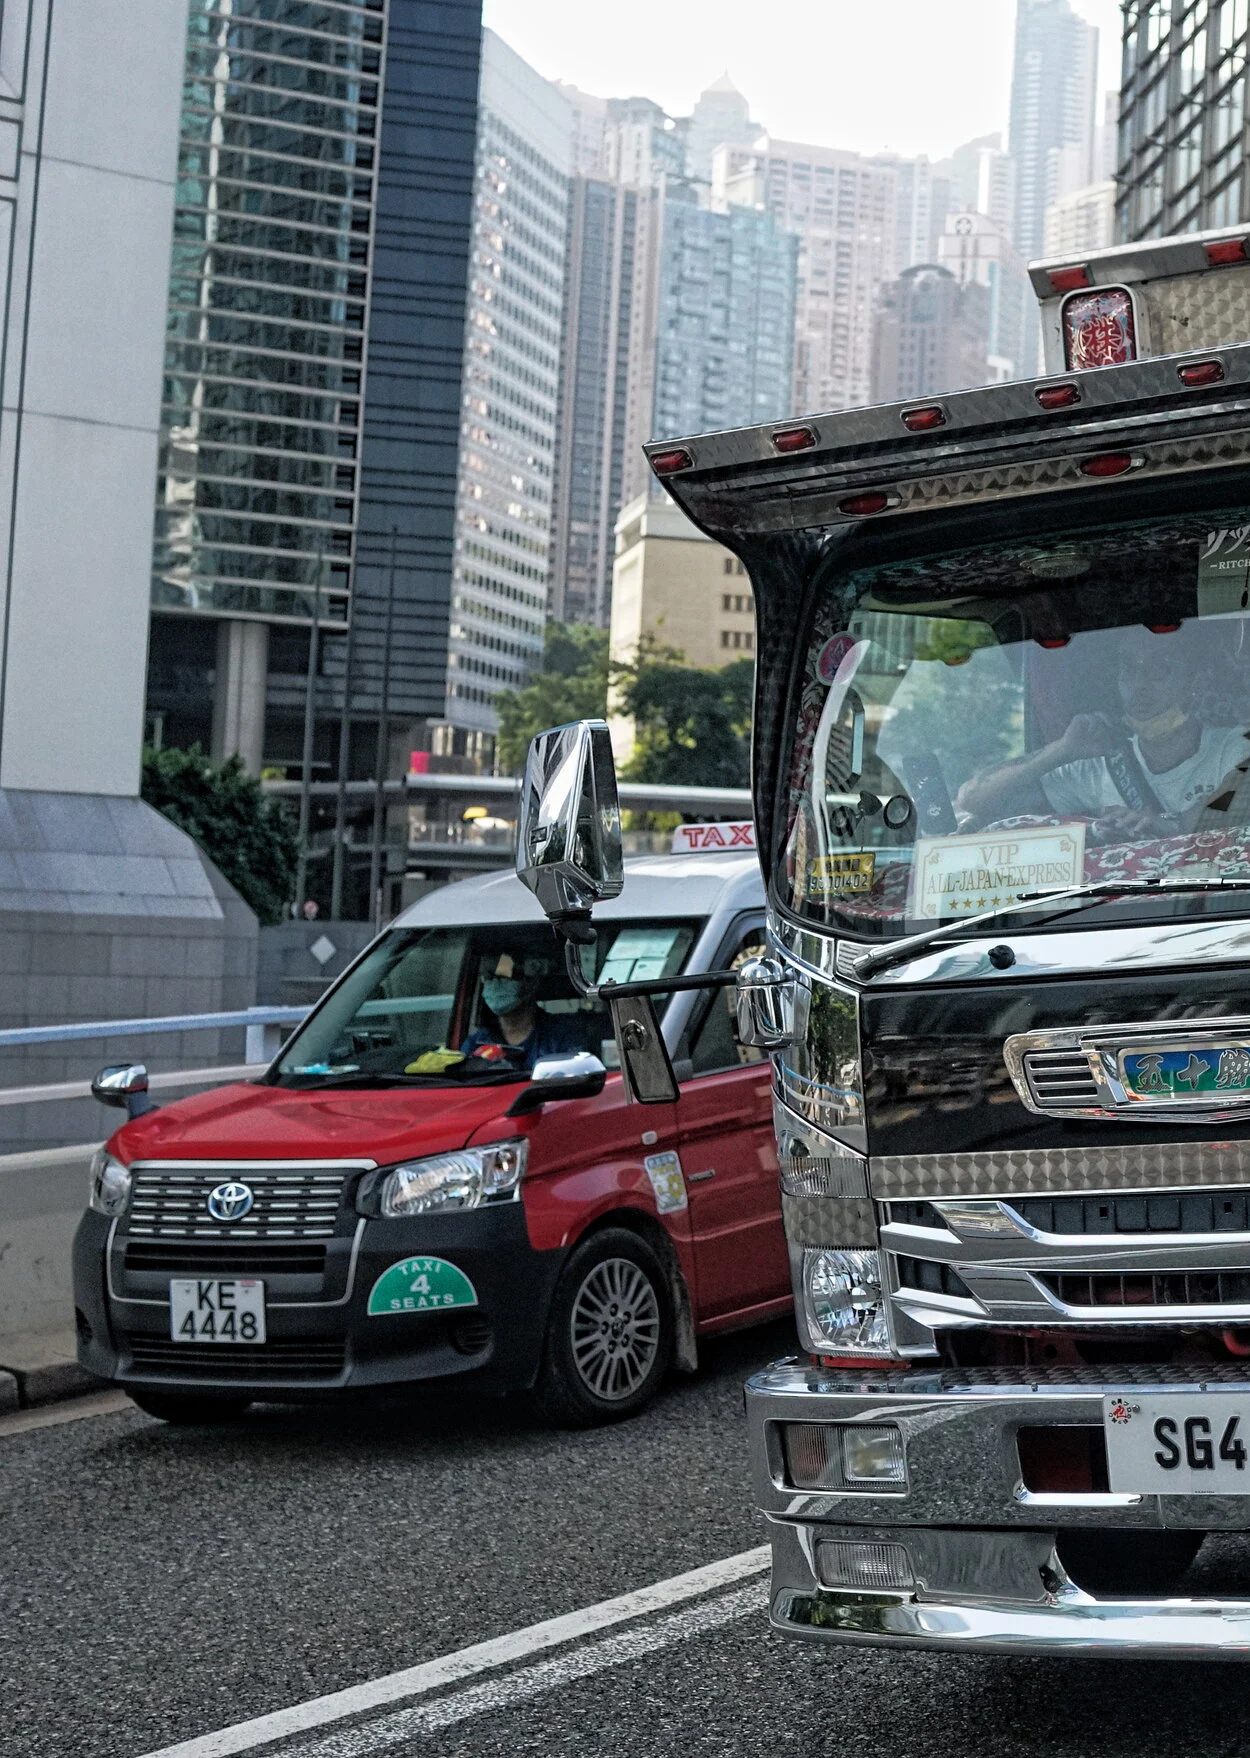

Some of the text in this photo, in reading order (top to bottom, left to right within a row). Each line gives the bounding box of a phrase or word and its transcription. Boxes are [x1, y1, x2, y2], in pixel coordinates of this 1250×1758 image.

[682, 824, 755, 848] TAX
[979, 844, 1019, 866] VIP
[927, 862, 1072, 895] ALL-JAPAN-EXPRESS
[398, 1261, 442, 1275] TAXI
[197, 1281, 237, 1310] KE
[410, 1274, 431, 1294] 4
[390, 1293, 454, 1309] SEATS
[180, 1311, 258, 1340] 4448
[1154, 1416, 1248, 1470] SG4
